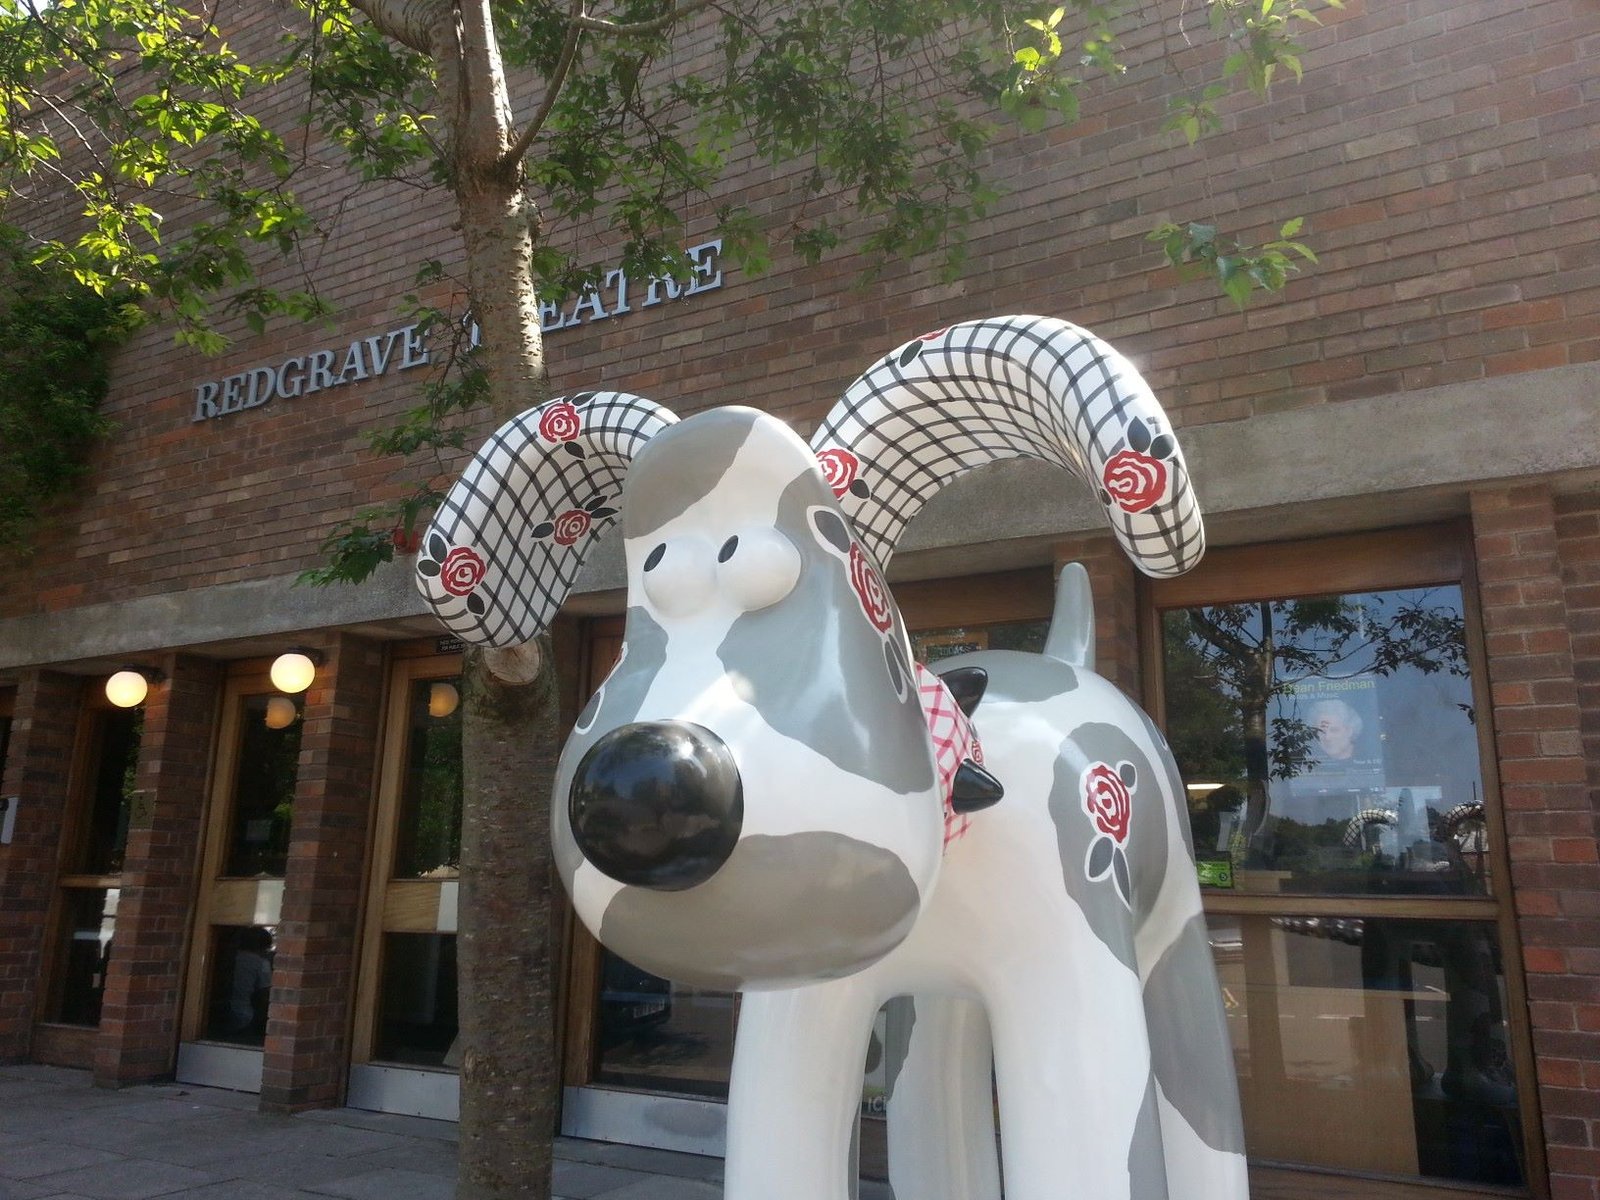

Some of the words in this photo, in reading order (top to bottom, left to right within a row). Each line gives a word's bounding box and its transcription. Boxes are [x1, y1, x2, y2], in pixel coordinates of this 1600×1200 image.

[192, 323, 430, 422] REDGRAVE
[461, 239, 722, 352] EATRE
[1318, 680, 1375, 691] Friedman
